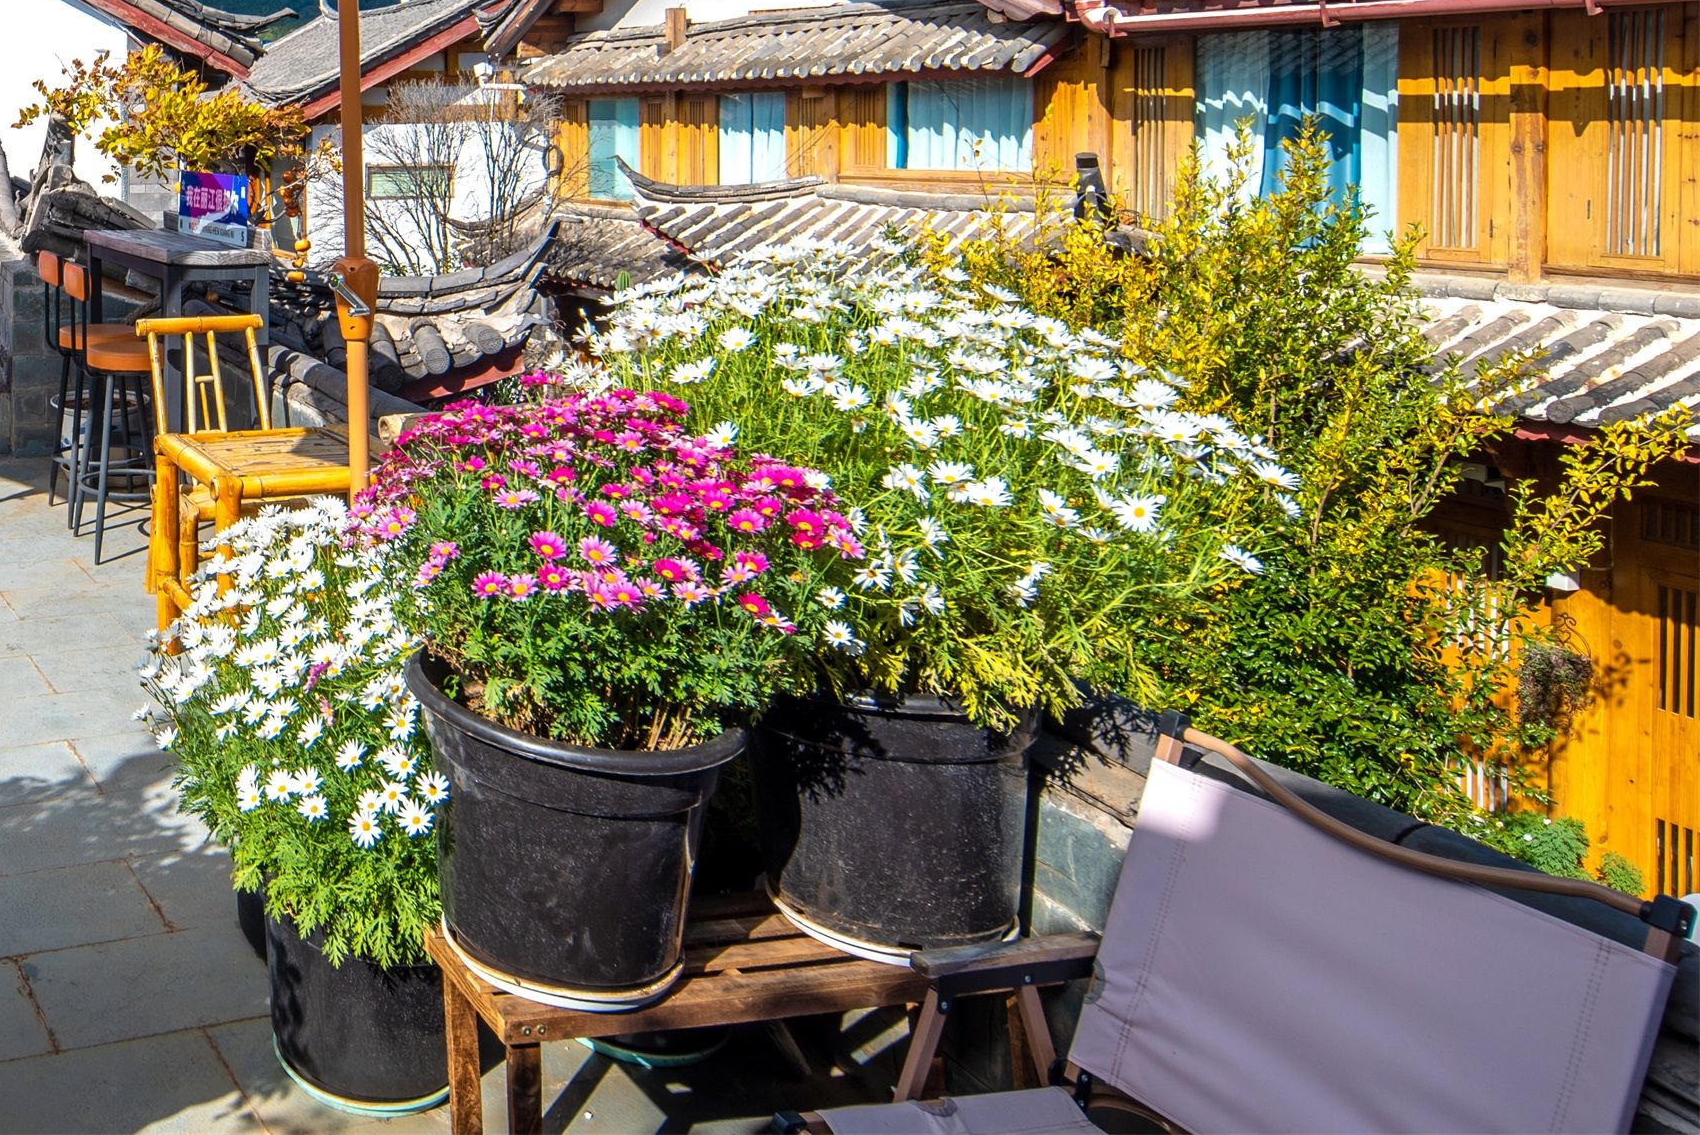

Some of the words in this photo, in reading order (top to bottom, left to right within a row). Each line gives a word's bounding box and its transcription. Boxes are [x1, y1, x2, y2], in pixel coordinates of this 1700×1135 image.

[186, 185, 239, 212] 我在丽江很想你
[241, 231, 245, 242] S
